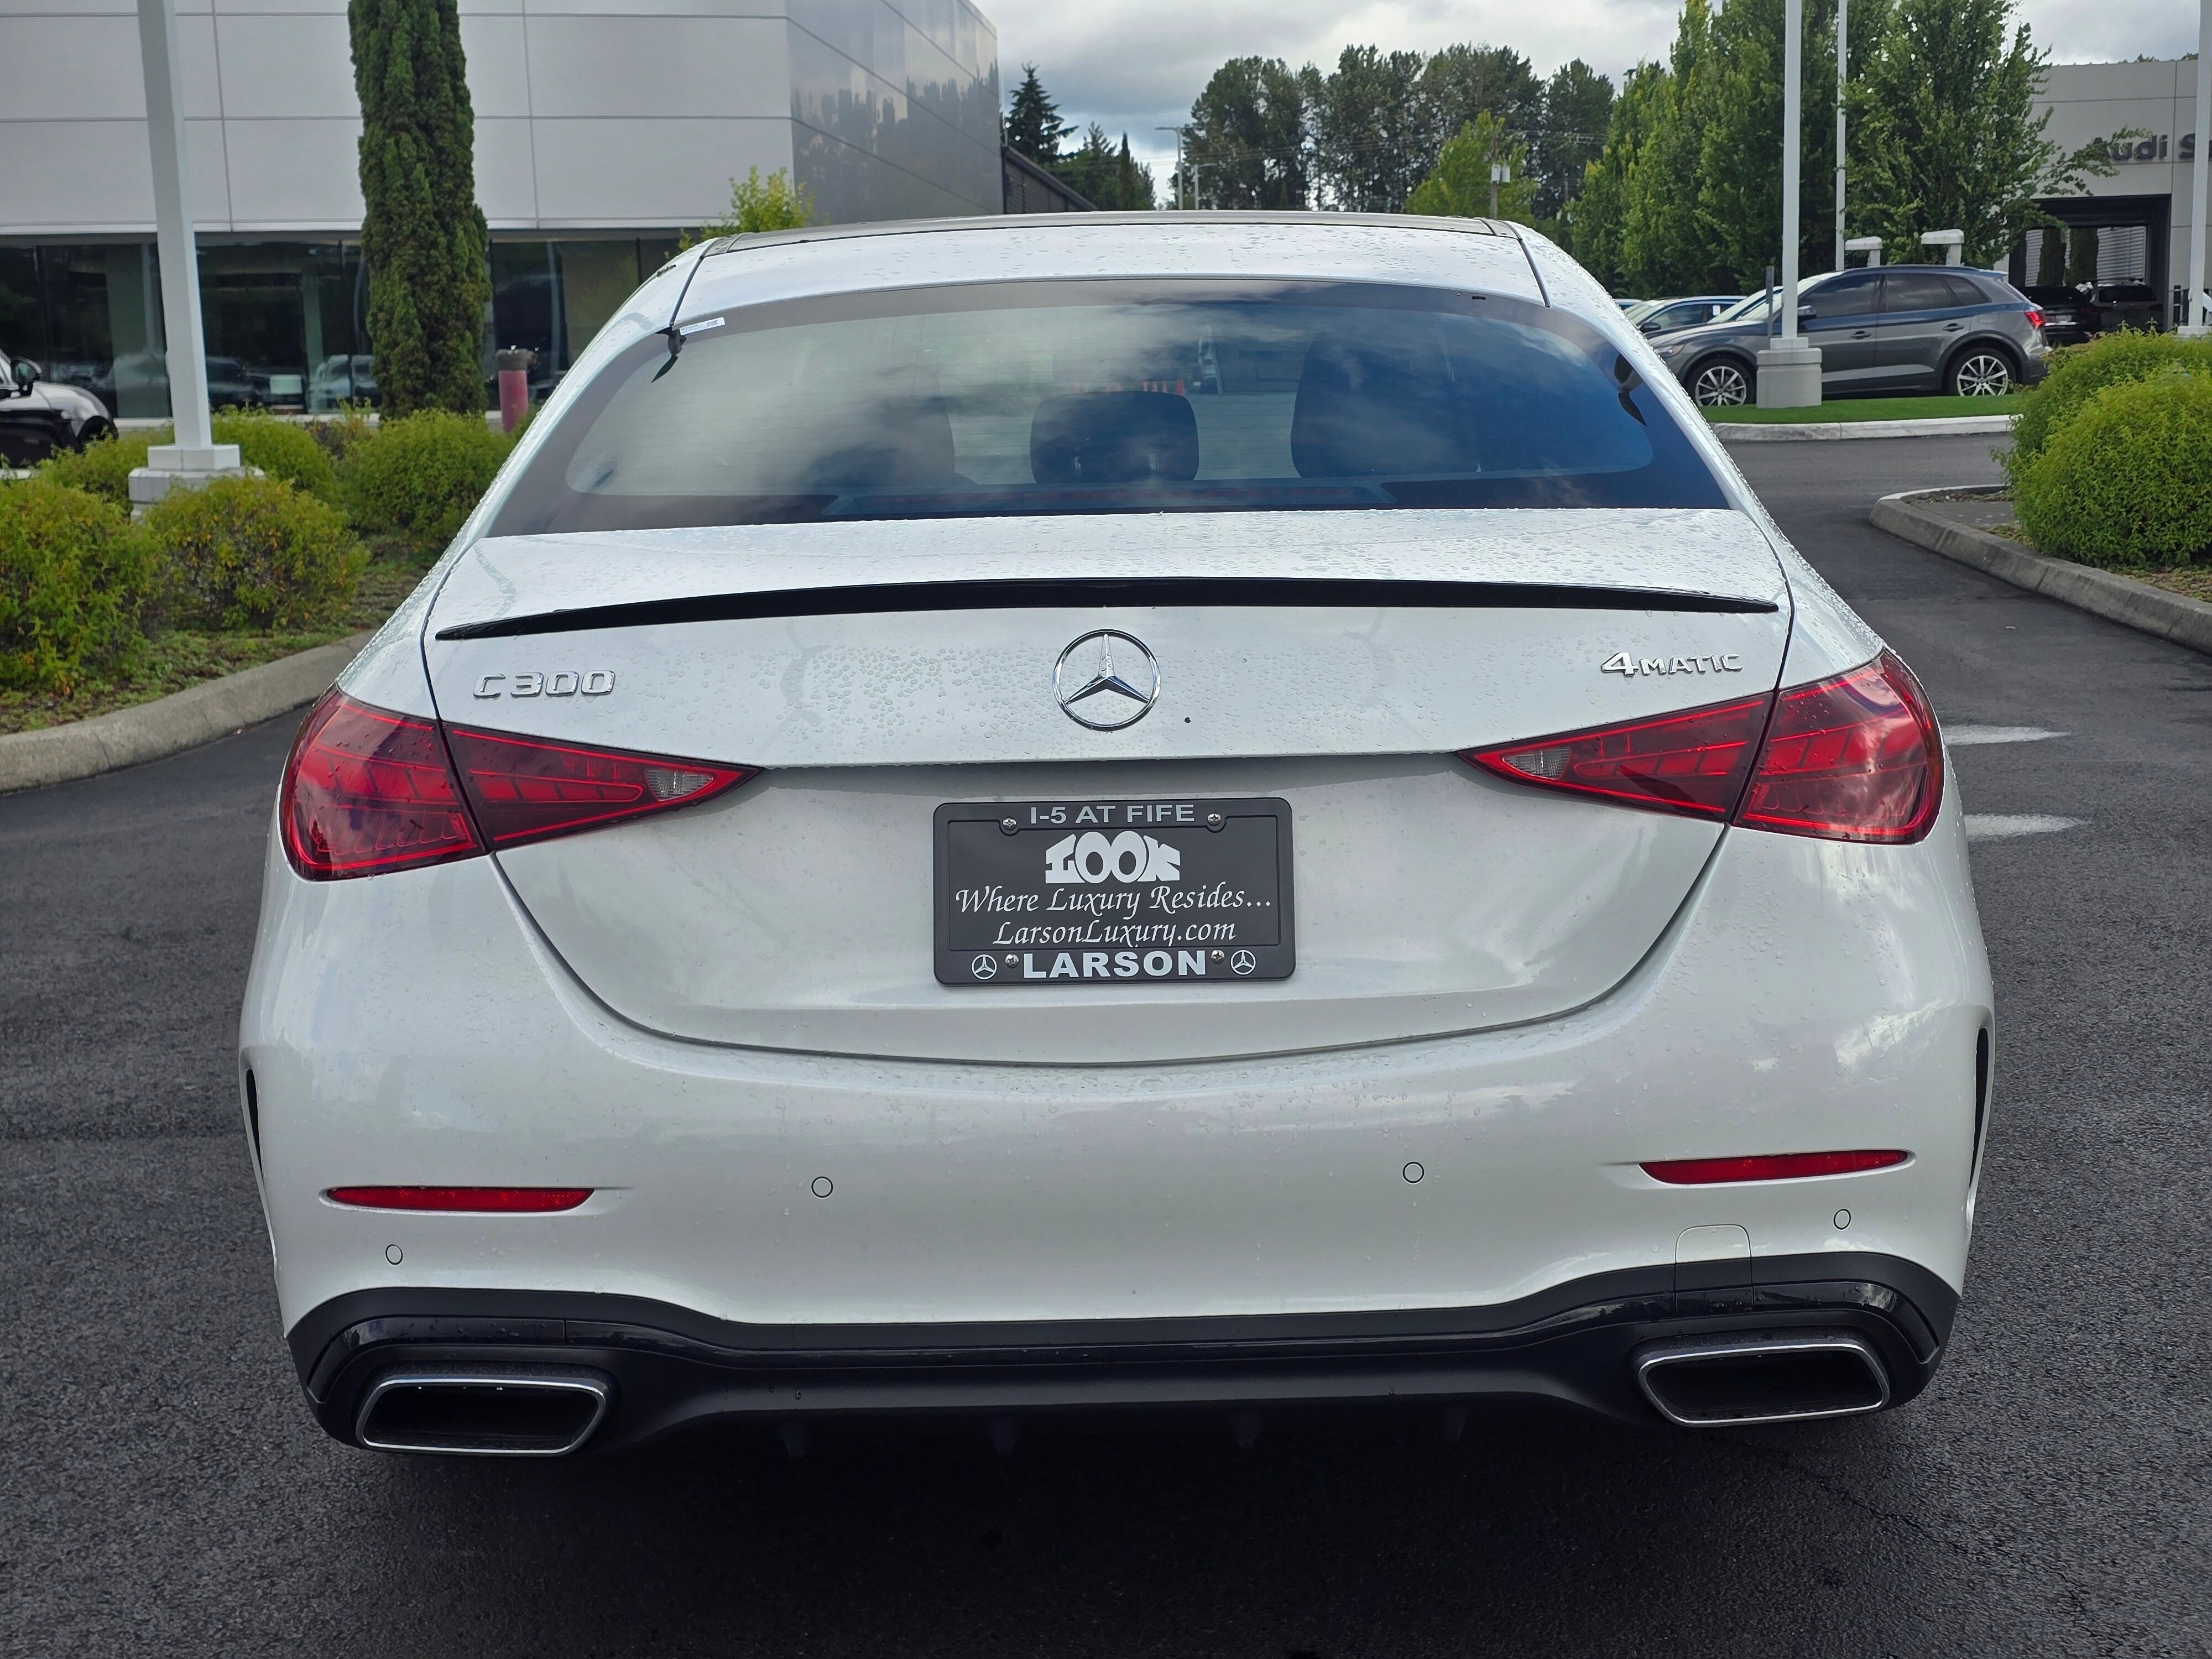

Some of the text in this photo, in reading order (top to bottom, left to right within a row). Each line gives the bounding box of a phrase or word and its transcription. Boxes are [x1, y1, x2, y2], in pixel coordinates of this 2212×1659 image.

[1601, 651, 1743, 676] 4MATIC
[1031, 805, 1194, 824] I-5 AT FIFE
[1045, 831, 1180, 883] LOOK
[956, 882, 1270, 920] Where Luxury Resides...
[993, 920, 1236, 947] LarsonLuxury.com
[1024, 951, 1205, 978] LARSON
